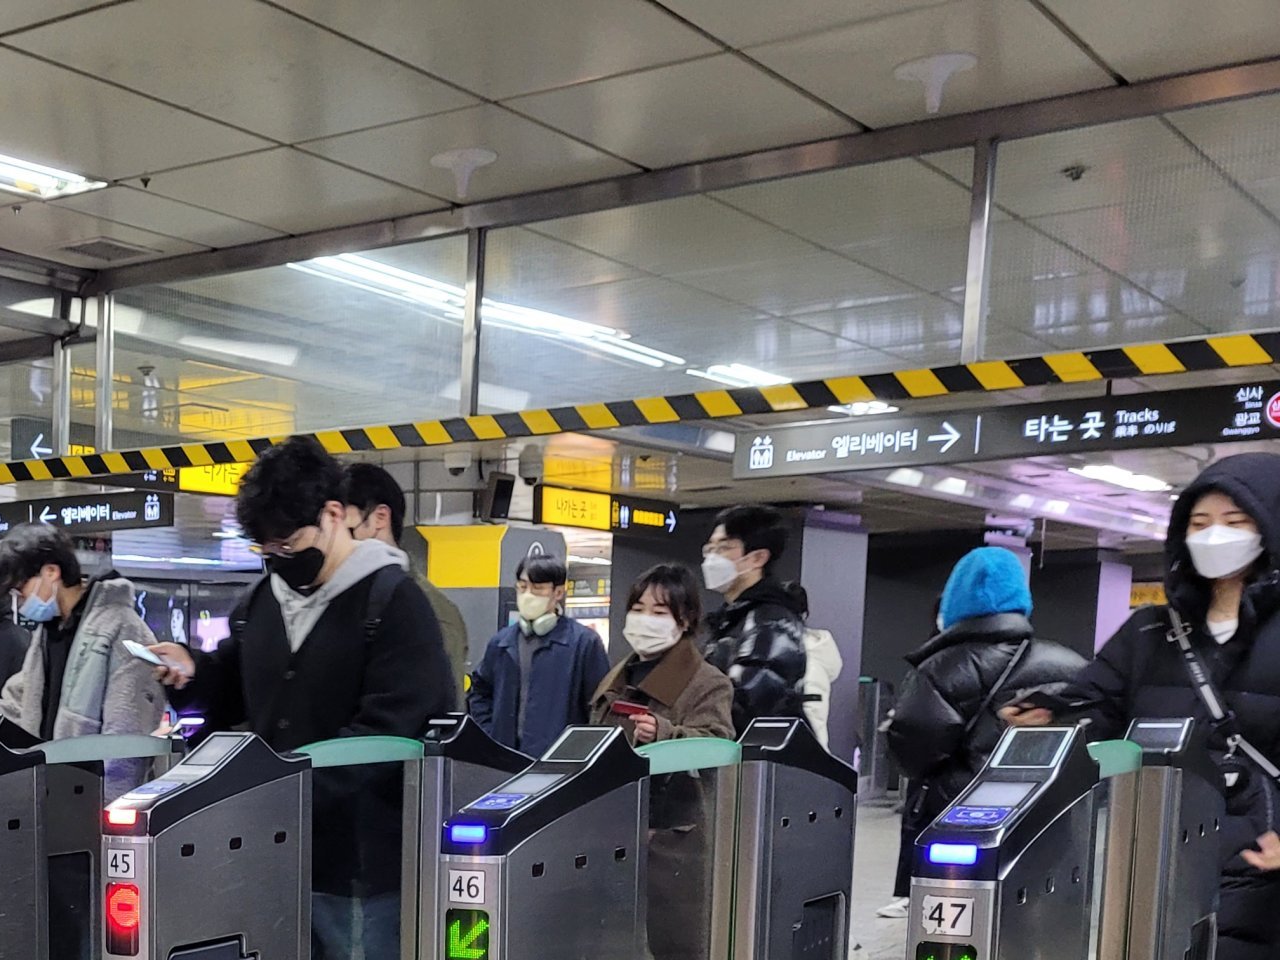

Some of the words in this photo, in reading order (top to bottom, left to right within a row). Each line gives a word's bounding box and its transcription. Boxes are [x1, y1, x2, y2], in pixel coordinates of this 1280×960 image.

[1235, 386, 1264, 402] 신사
[1024, 414, 1074, 443] 타는
[1077, 410, 1106, 440] 곳
[1116, 408, 1160, 424] Tracks
[1235, 412, 1261, 427] 광교
[831, 428, 919, 459] 엘리베이터
[786, 449, 828, 463] Elevator
[60, 503, 111, 525] 엘리베이터
[110, 853, 131, 873] 45
[452, 875, 480, 899] 46
[928, 902, 967, 929] 47
